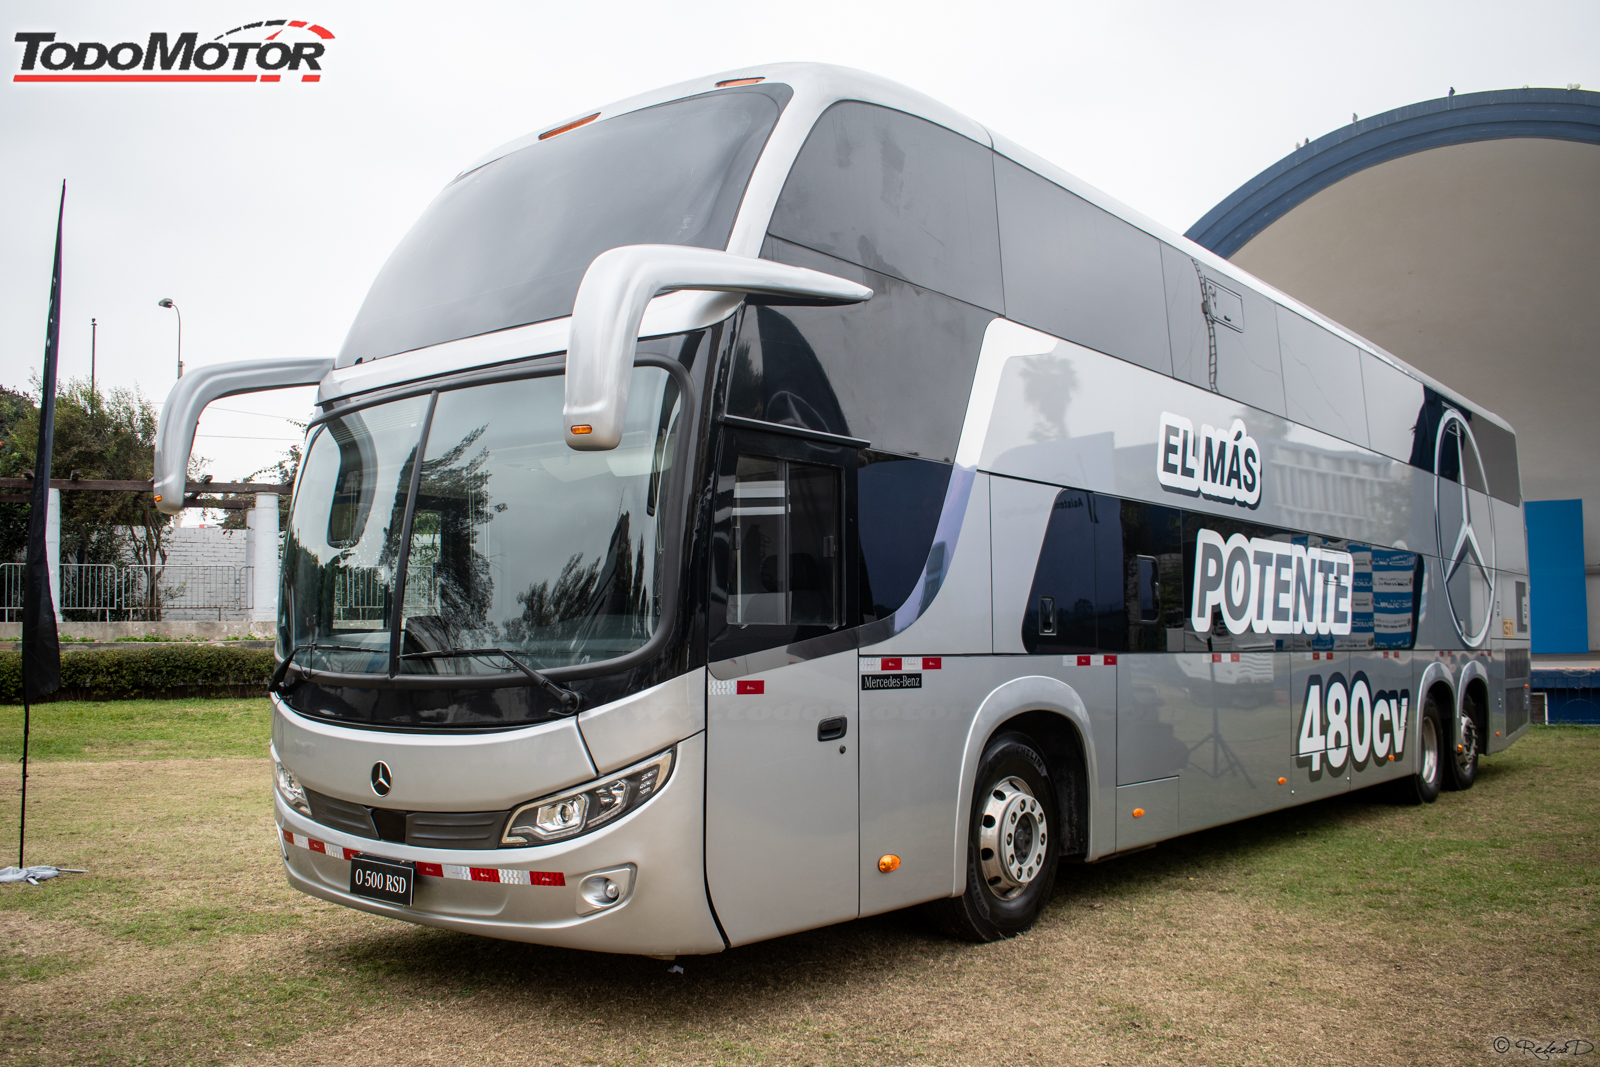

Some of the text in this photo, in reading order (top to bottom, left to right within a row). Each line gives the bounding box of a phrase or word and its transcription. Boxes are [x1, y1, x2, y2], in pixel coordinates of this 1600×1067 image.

[1163, 424, 1257, 494] EL MÁS
[1196, 542, 1351, 624] POTENTE
[864, 675, 920, 689] Mercedes-Benz
[364, 870, 384, 890] 500
[385, 873, 407, 894] RSD
